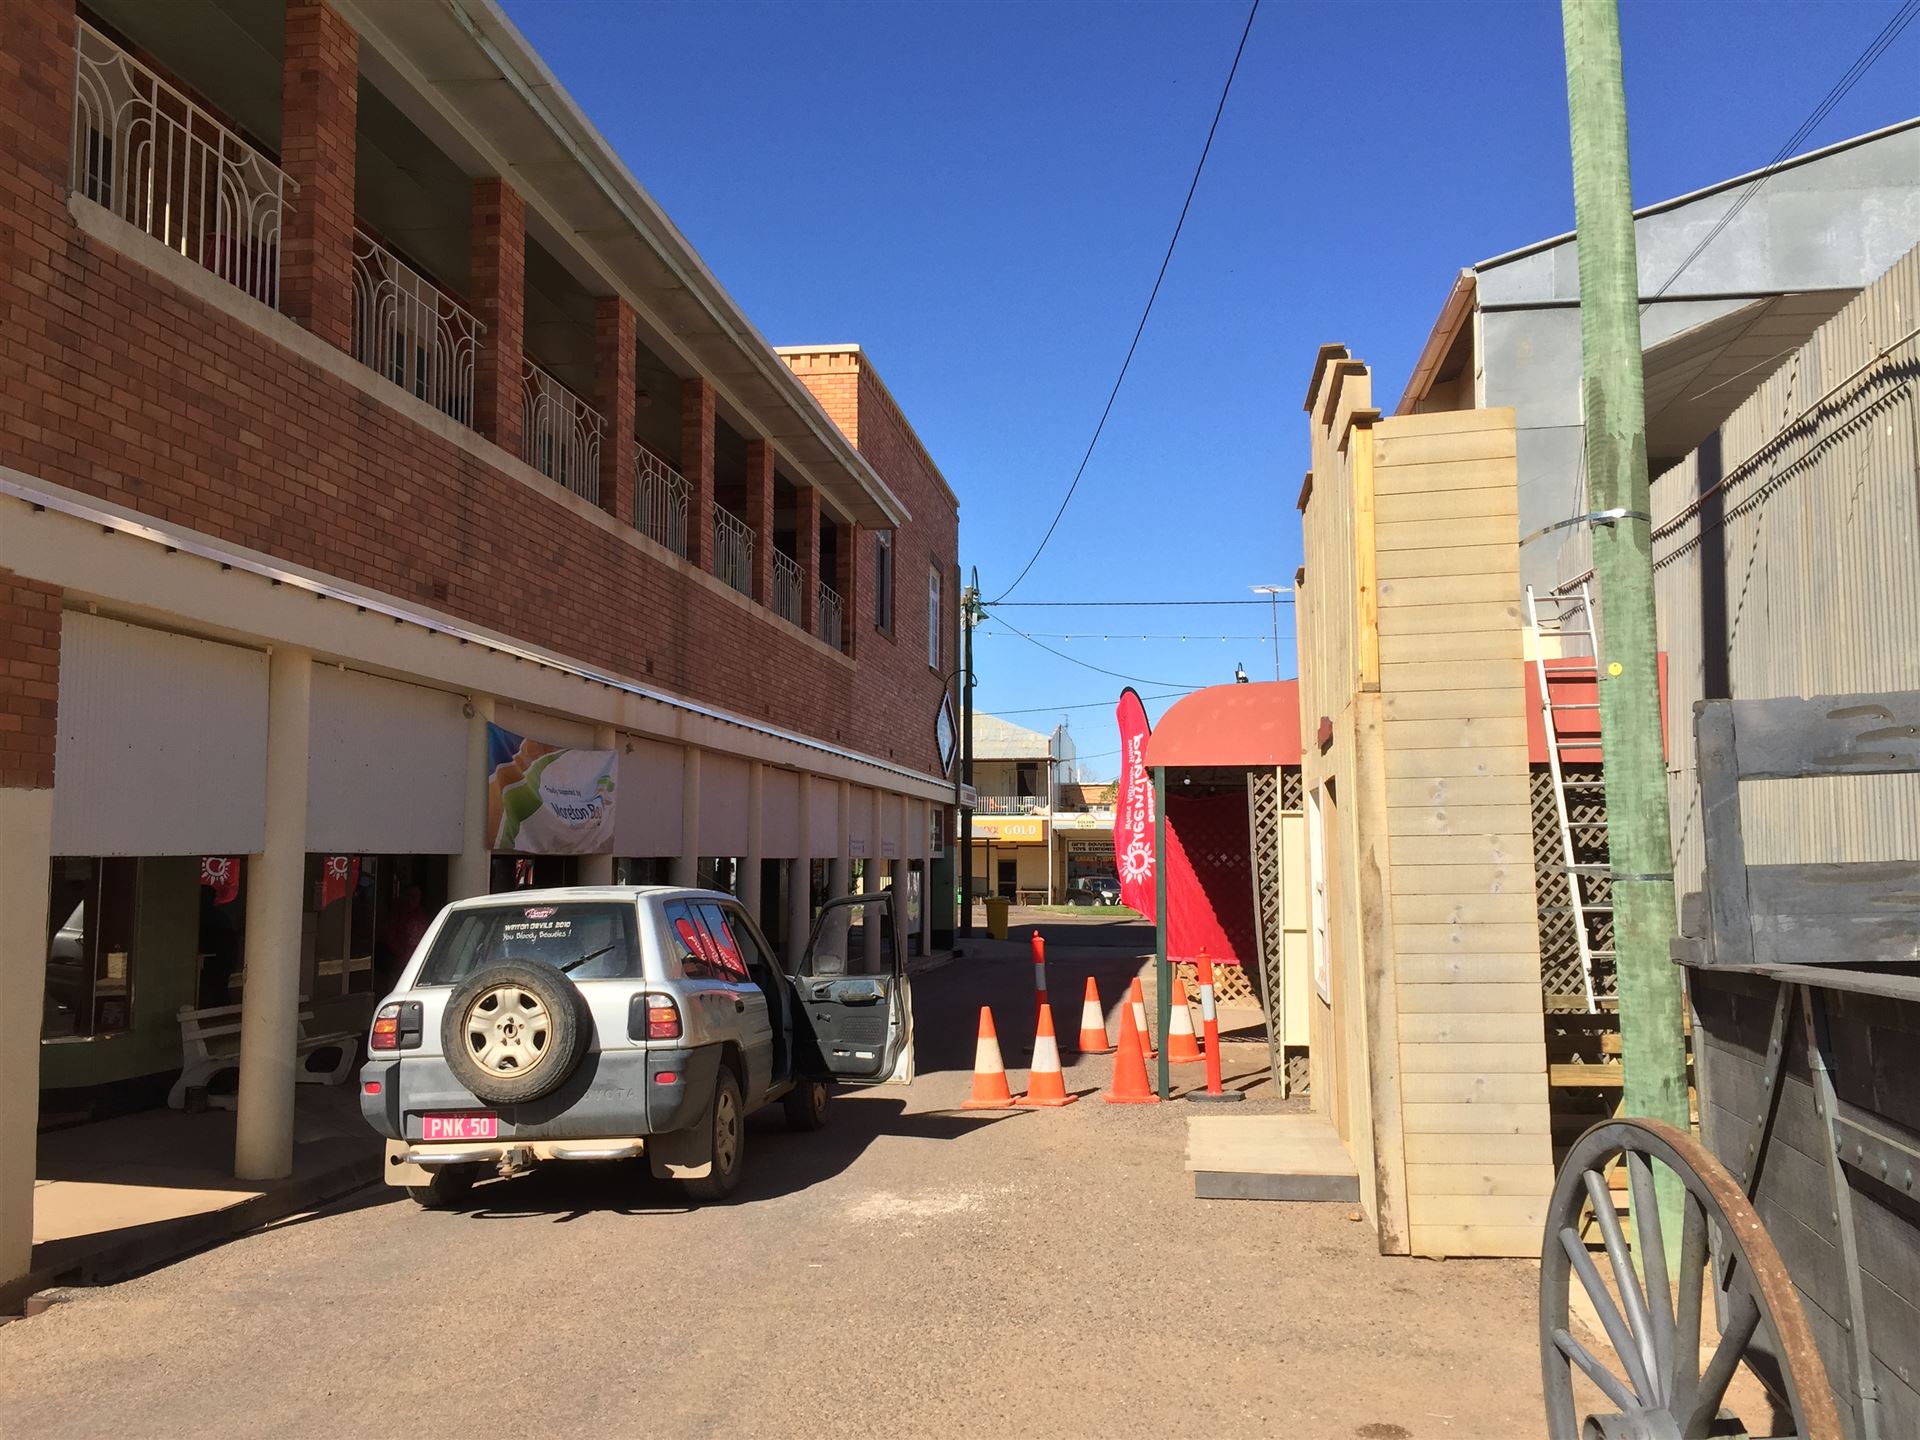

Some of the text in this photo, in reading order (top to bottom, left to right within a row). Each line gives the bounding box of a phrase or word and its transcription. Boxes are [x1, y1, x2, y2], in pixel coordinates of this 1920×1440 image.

[1005, 824, 1036, 835] GOLD
[554, 921, 571, 929] 2010
[502, 932, 515, 942] You
[516, 931, 537, 942] Bloody
